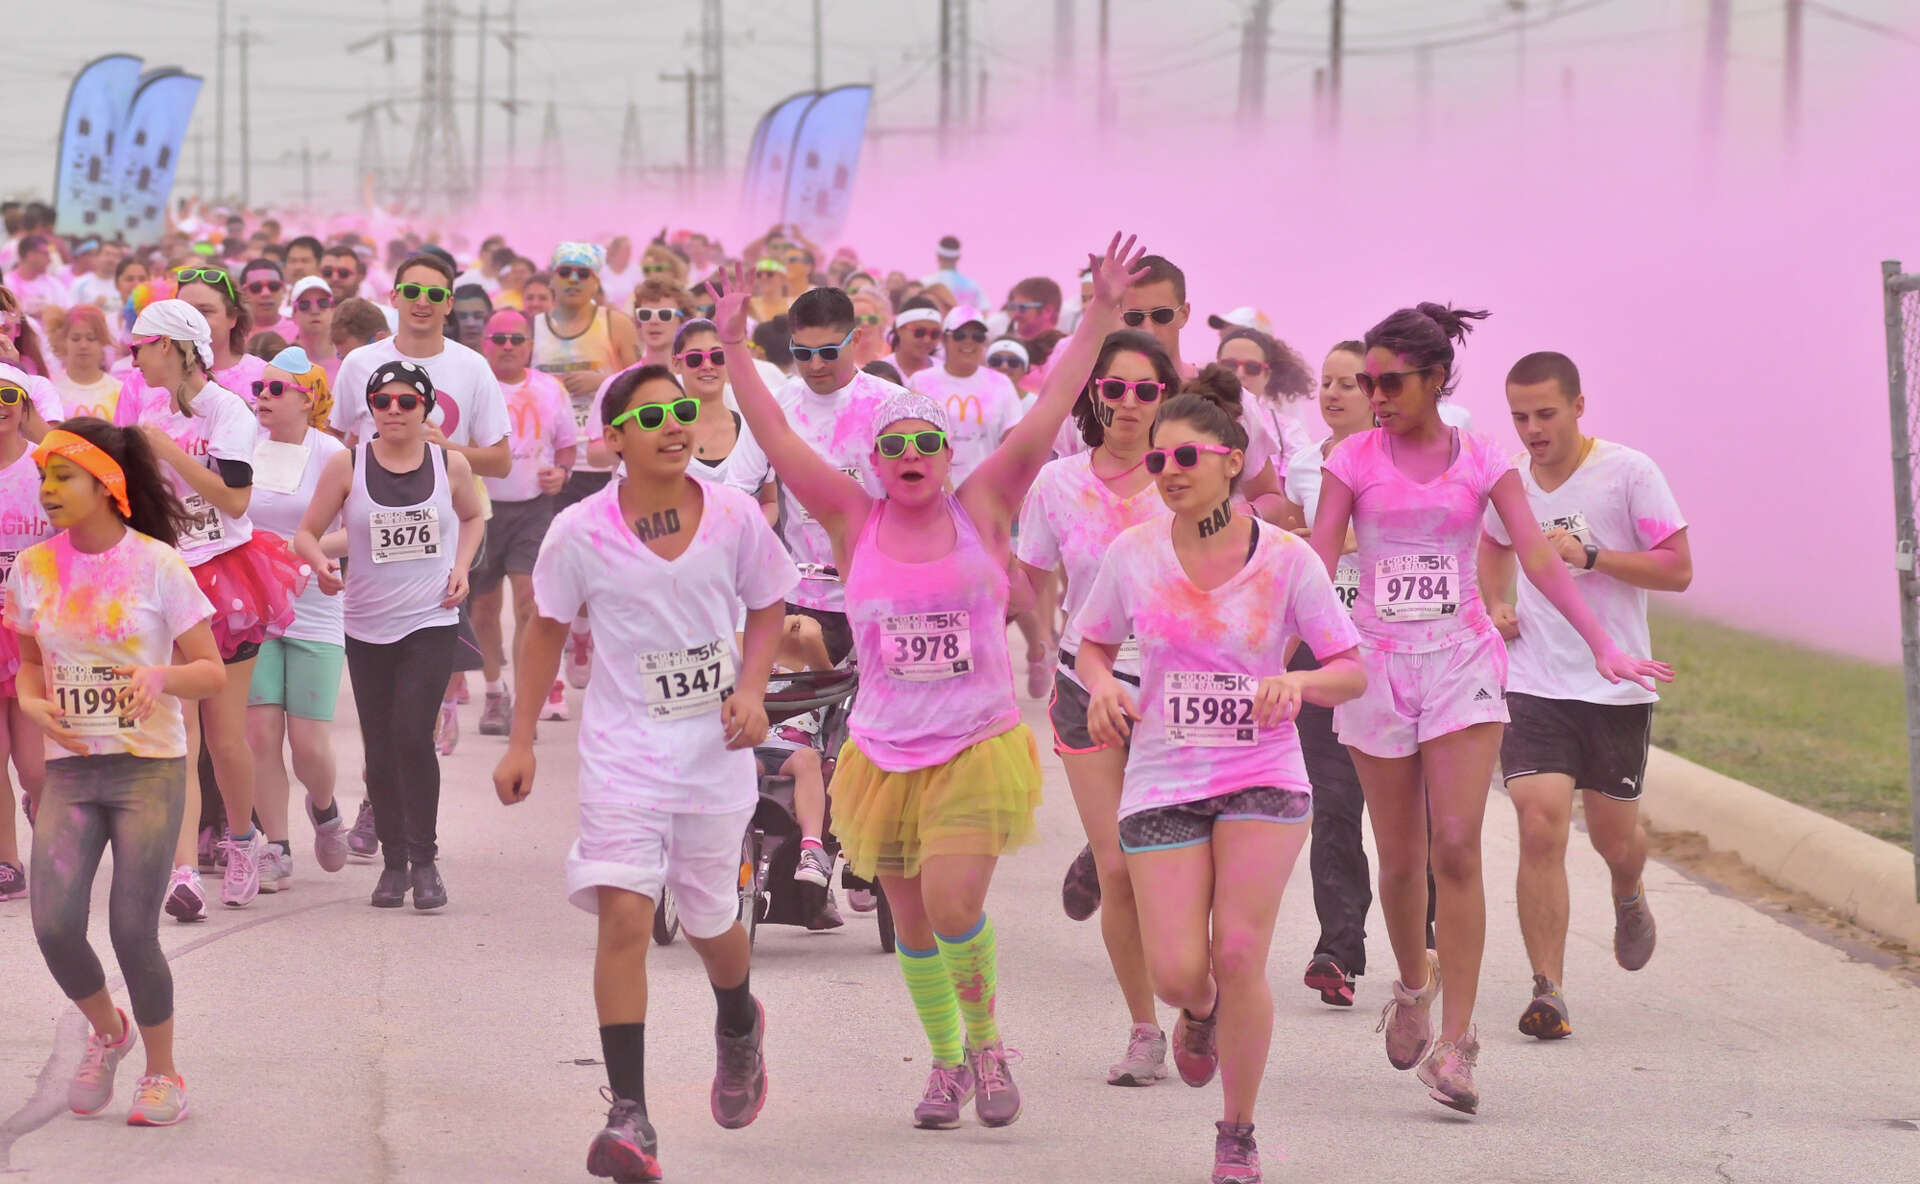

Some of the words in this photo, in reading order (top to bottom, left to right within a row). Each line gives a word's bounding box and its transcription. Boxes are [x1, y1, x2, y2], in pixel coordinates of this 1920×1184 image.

[413, 508, 433, 522] 5K
[634, 508, 681, 542] RAD
[380, 524, 431, 548] 3676
[1429, 555, 1453, 571] 5K
[1387, 575, 1450, 602] 9784
[937, 612, 962, 630] 5K
[700, 640, 722, 662] 5K
[894, 634, 960, 662] 3978
[656, 661, 721, 700] 1347
[1224, 675, 1251, 692] 5K
[1168, 696, 1255, 725] 15982
